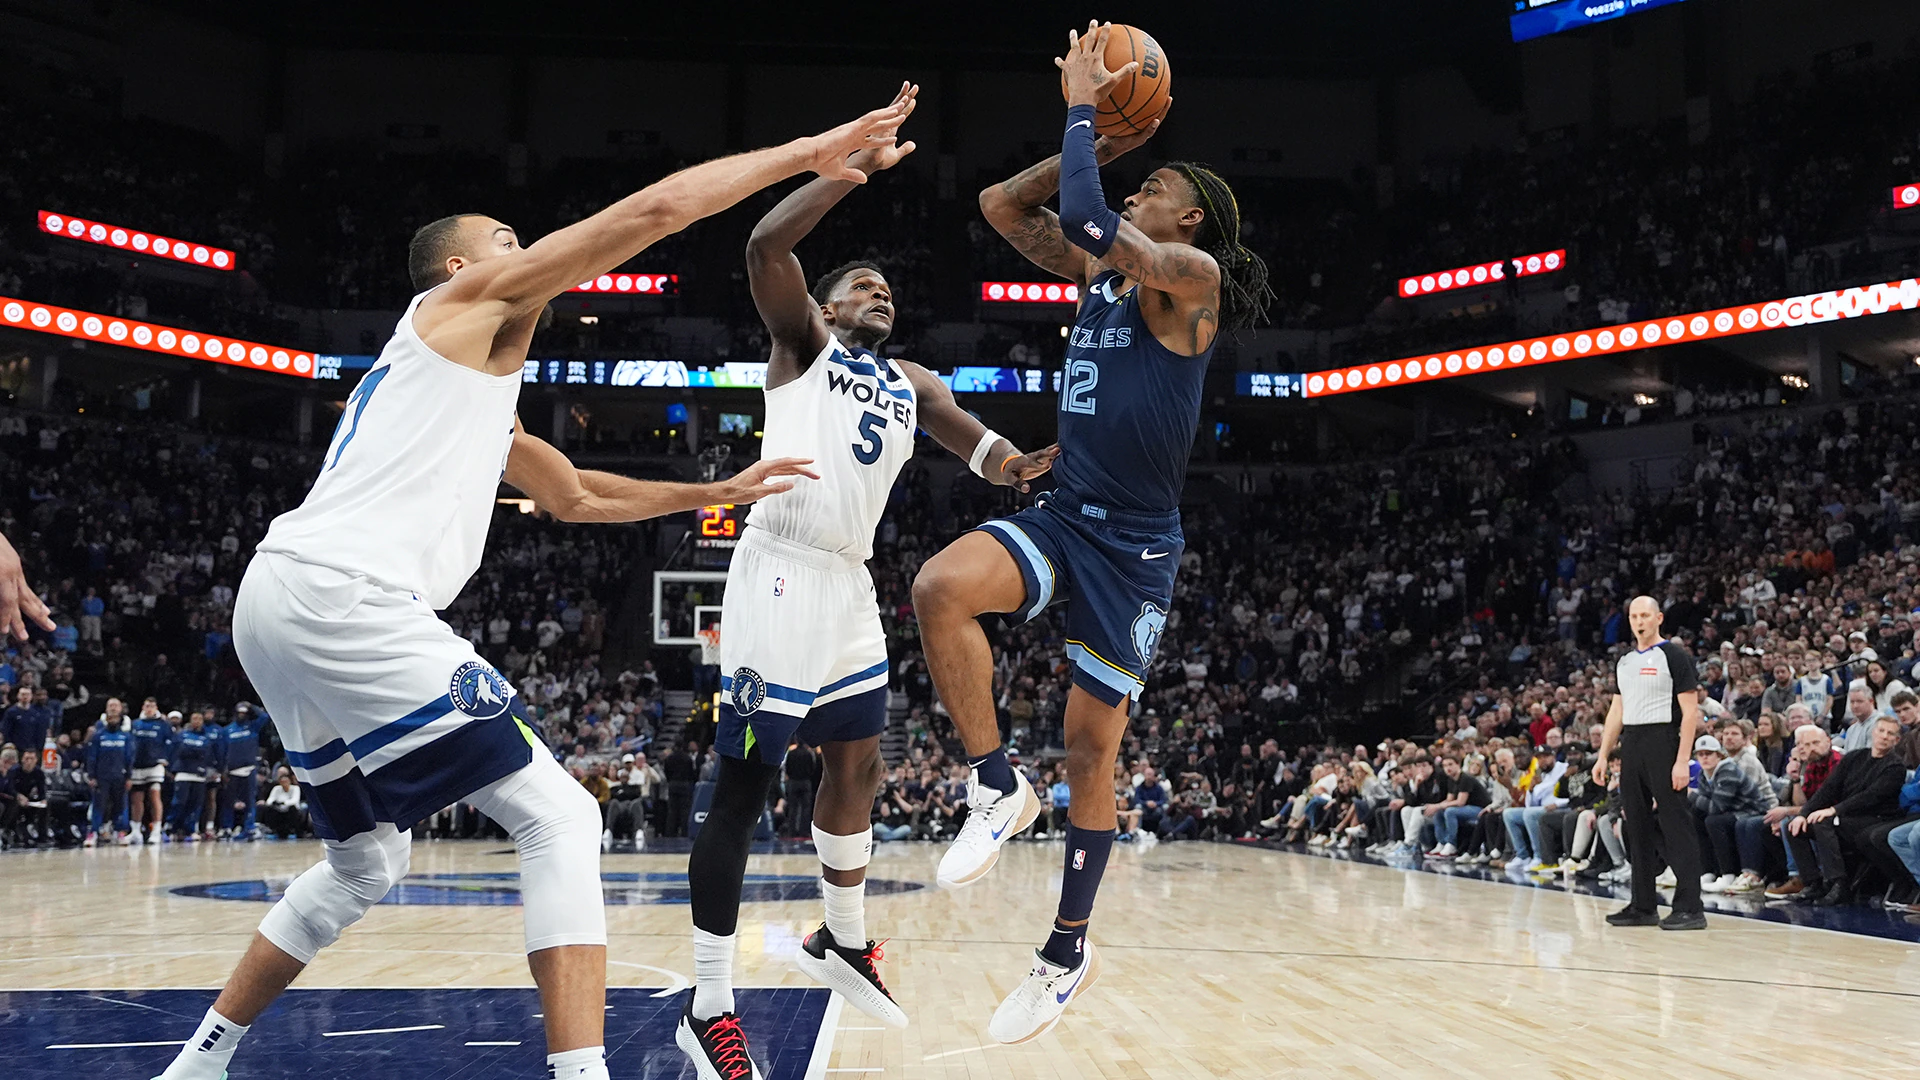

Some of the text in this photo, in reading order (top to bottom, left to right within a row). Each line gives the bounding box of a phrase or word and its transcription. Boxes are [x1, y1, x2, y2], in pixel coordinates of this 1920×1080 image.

[320, 356, 342, 369] HOU
[320, 368, 341, 380] ATL
[1061, 357, 1099, 415] 12
[1250, 374, 1272, 386] UTA
[319, 363, 391, 473] 7
[851, 410, 888, 466] 5
